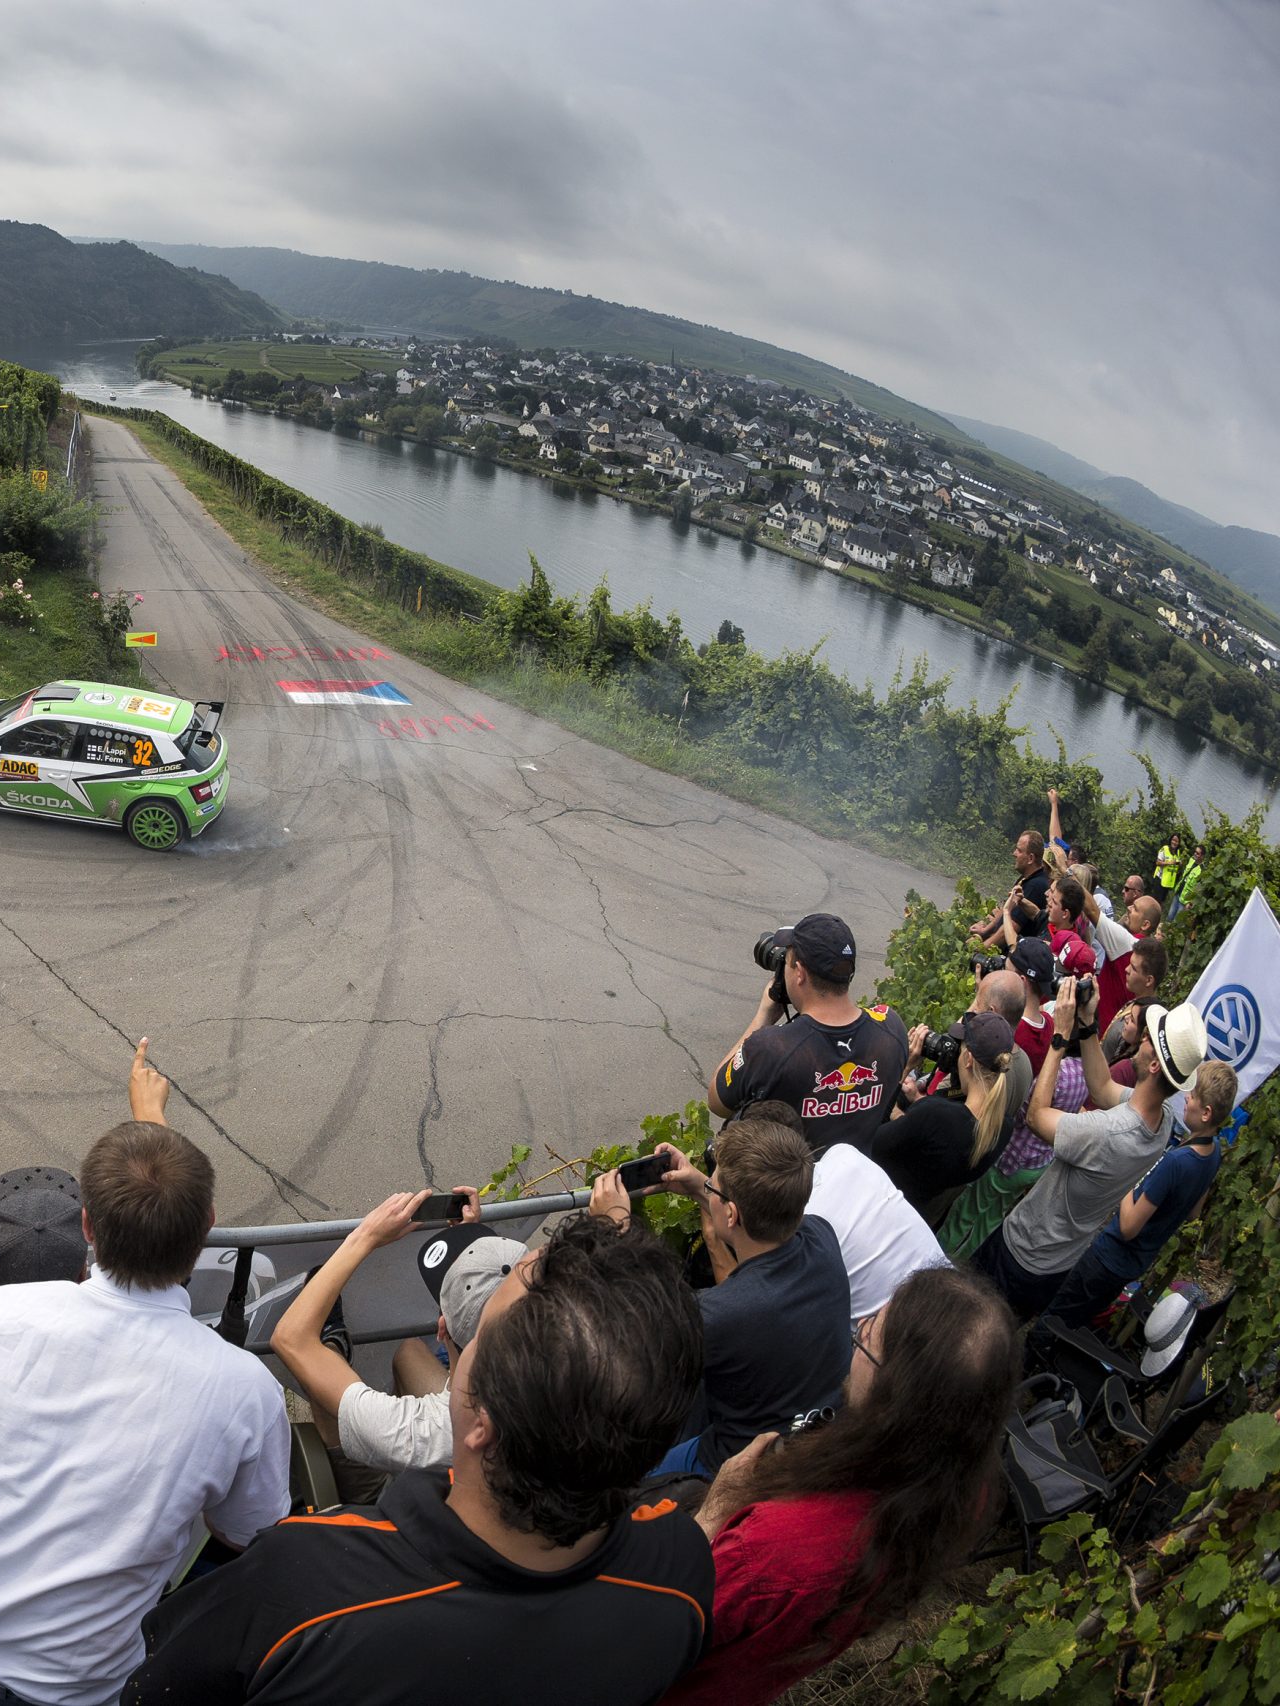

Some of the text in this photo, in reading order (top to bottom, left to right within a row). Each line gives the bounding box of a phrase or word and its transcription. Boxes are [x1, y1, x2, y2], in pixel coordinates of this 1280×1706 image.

[106, 747, 127, 756] Lappi
[133, 740, 153, 766] 32
[104, 755, 124, 764] Ferm
[2, 760, 36, 775] ADAC
[159, 763, 182, 773] EDGE
[6, 790, 74, 810] ŠKODA
[801, 1084, 883, 1118] Red Bull
